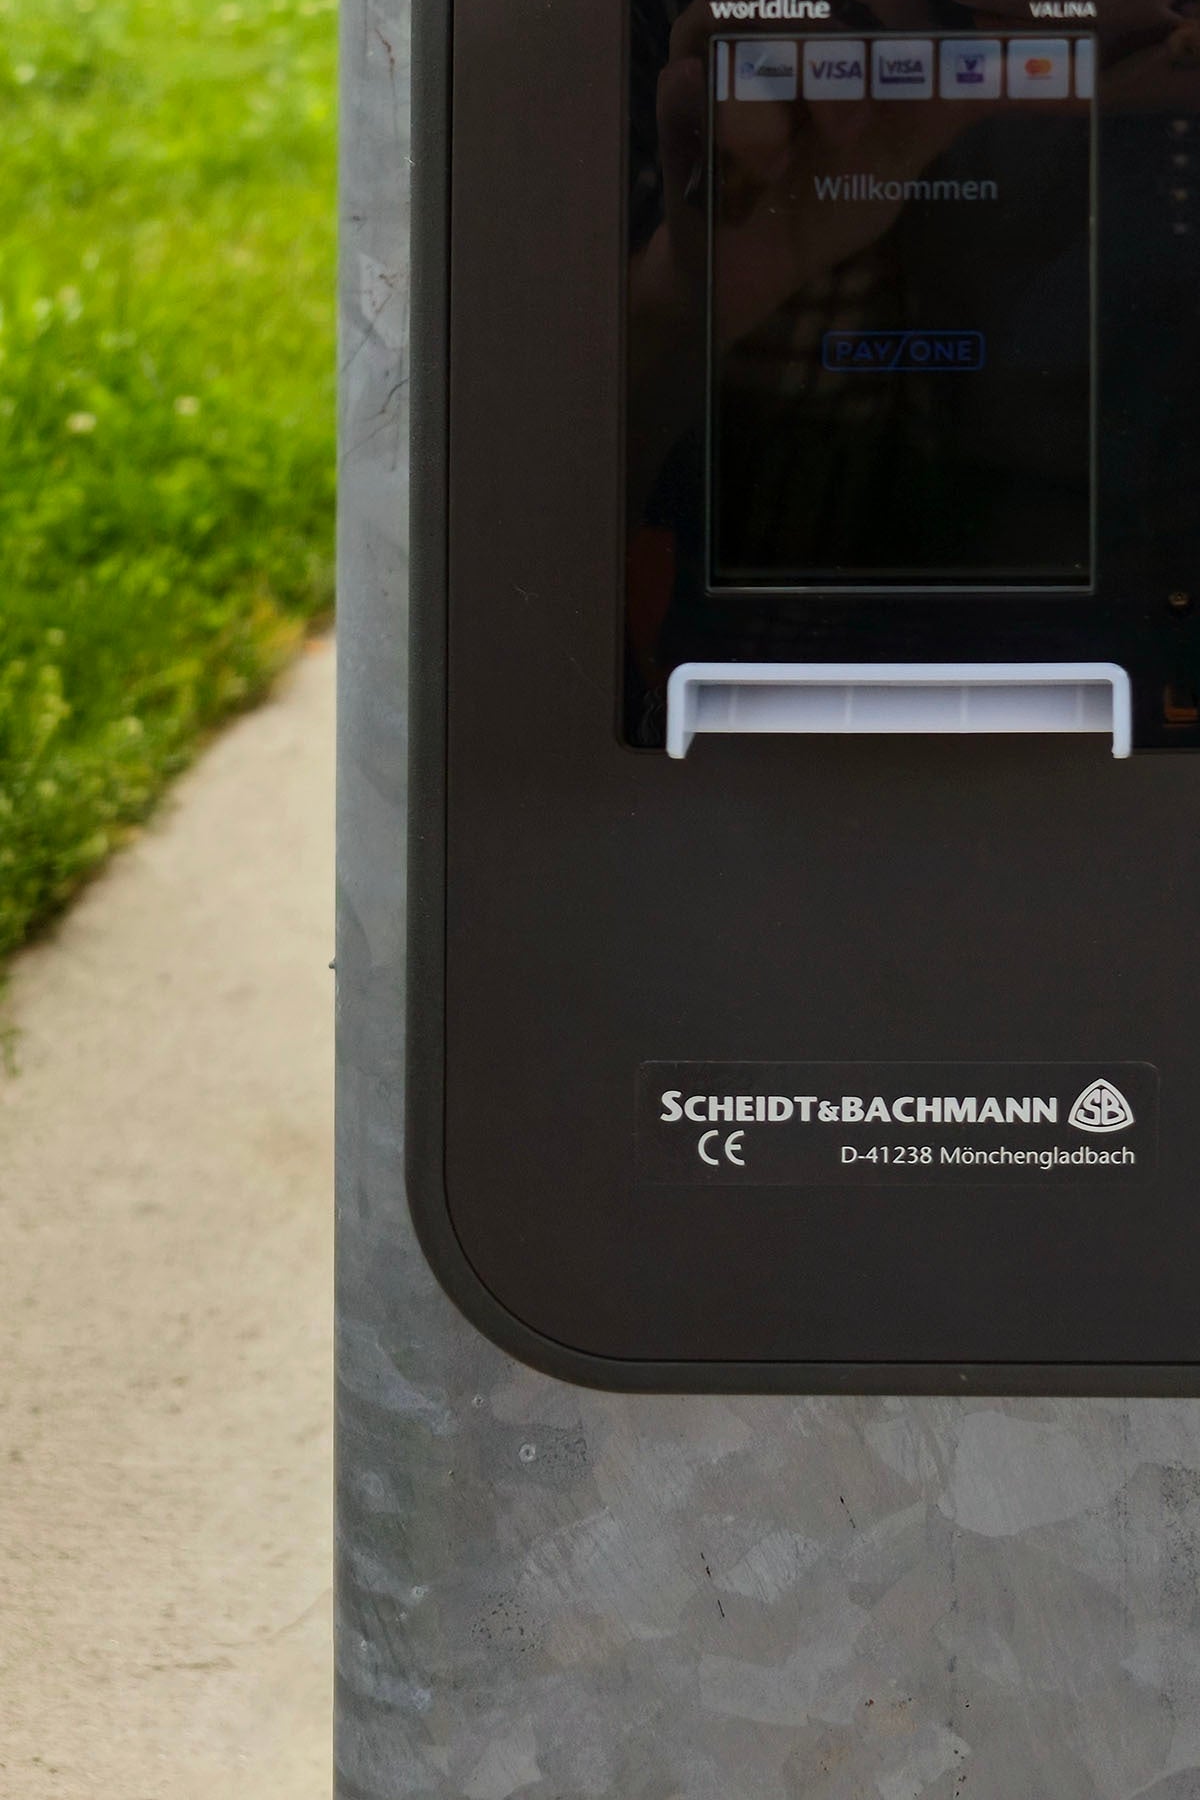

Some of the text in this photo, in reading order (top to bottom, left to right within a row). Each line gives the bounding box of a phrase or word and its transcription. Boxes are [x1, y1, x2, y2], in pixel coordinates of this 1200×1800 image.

[1029, 1, 1097, 18] VALINA
[810, 60, 863, 80] VISA
[813, 174, 998, 201] Willkommen
[841, 1144, 1135, 1170] D-41238 Mönchengladbach
